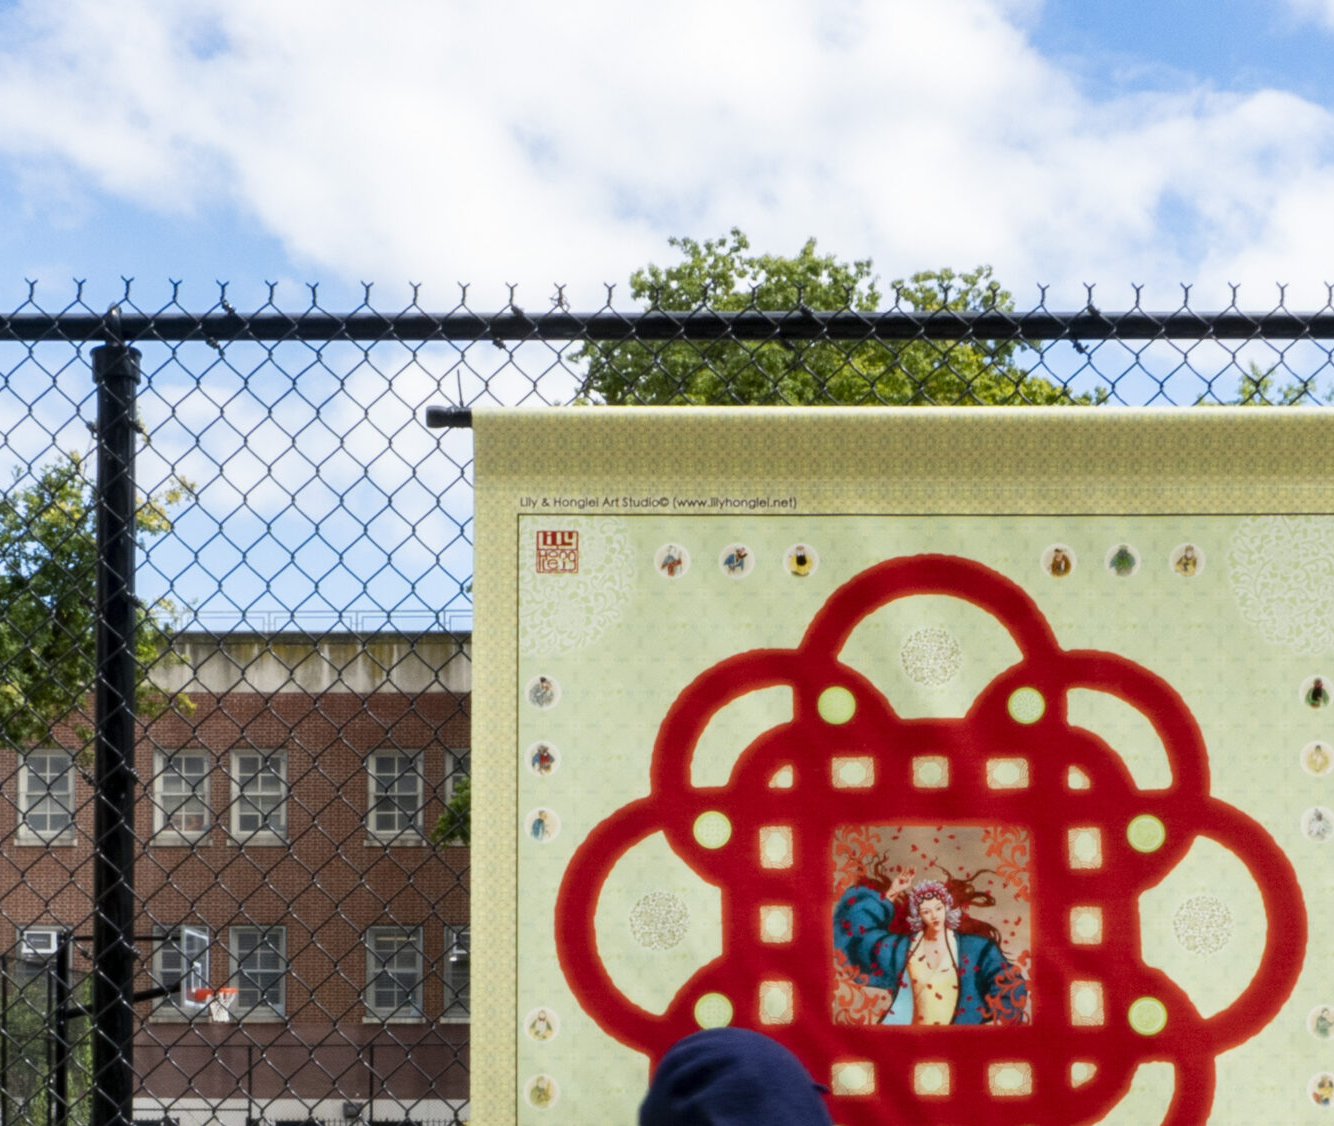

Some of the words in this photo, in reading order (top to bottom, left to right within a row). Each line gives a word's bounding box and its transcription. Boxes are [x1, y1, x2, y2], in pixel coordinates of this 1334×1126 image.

[519, 497, 538, 509] Lily
[542, 498, 549, 507] &
[553, 497, 599, 509] Honglei
[602, 497, 619, 508] Art
[622, 497, 669, 508] Studio©
[673, 497, 797, 510] (www.lilyhonglei.net)
